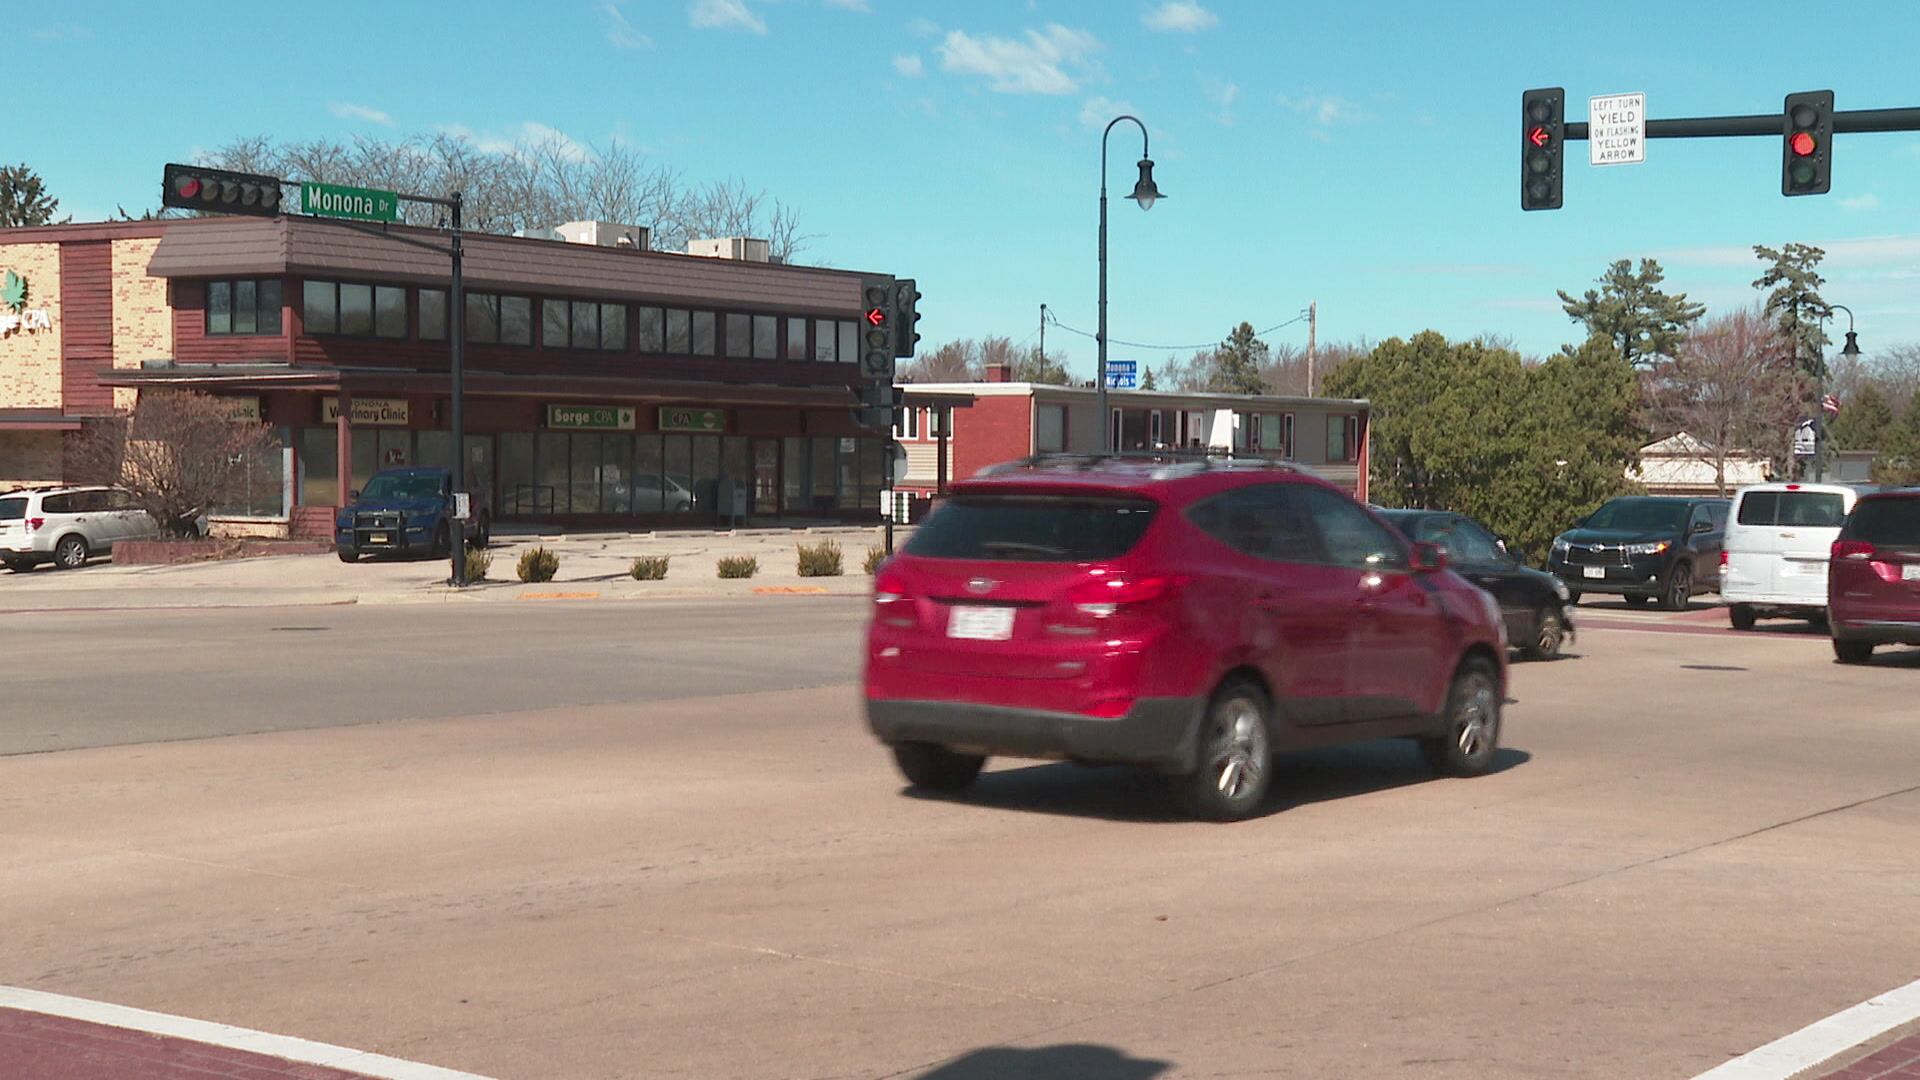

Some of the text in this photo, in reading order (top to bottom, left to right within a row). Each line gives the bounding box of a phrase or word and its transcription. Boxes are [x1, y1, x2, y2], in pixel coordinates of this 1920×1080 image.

[1593, 97, 1641, 111] LEFT TURN
[1599, 111, 1635, 124] YIELD
[1594, 125, 1639, 138] ON FLASHING
[1598, 137, 1637, 149] YELLOW
[1599, 149, 1635, 161] ARROW
[308, 185, 389, 215] Monona Dr
[22, 309, 51, 329] CPA
[1106, 375, 1129, 386] Nicols
[350, 400, 389, 408] ONONA
[329, 406, 406, 421] Vrinary Clinic
[554, 408, 613, 425] Sorge CPA
[671, 413, 690, 425] CPA
